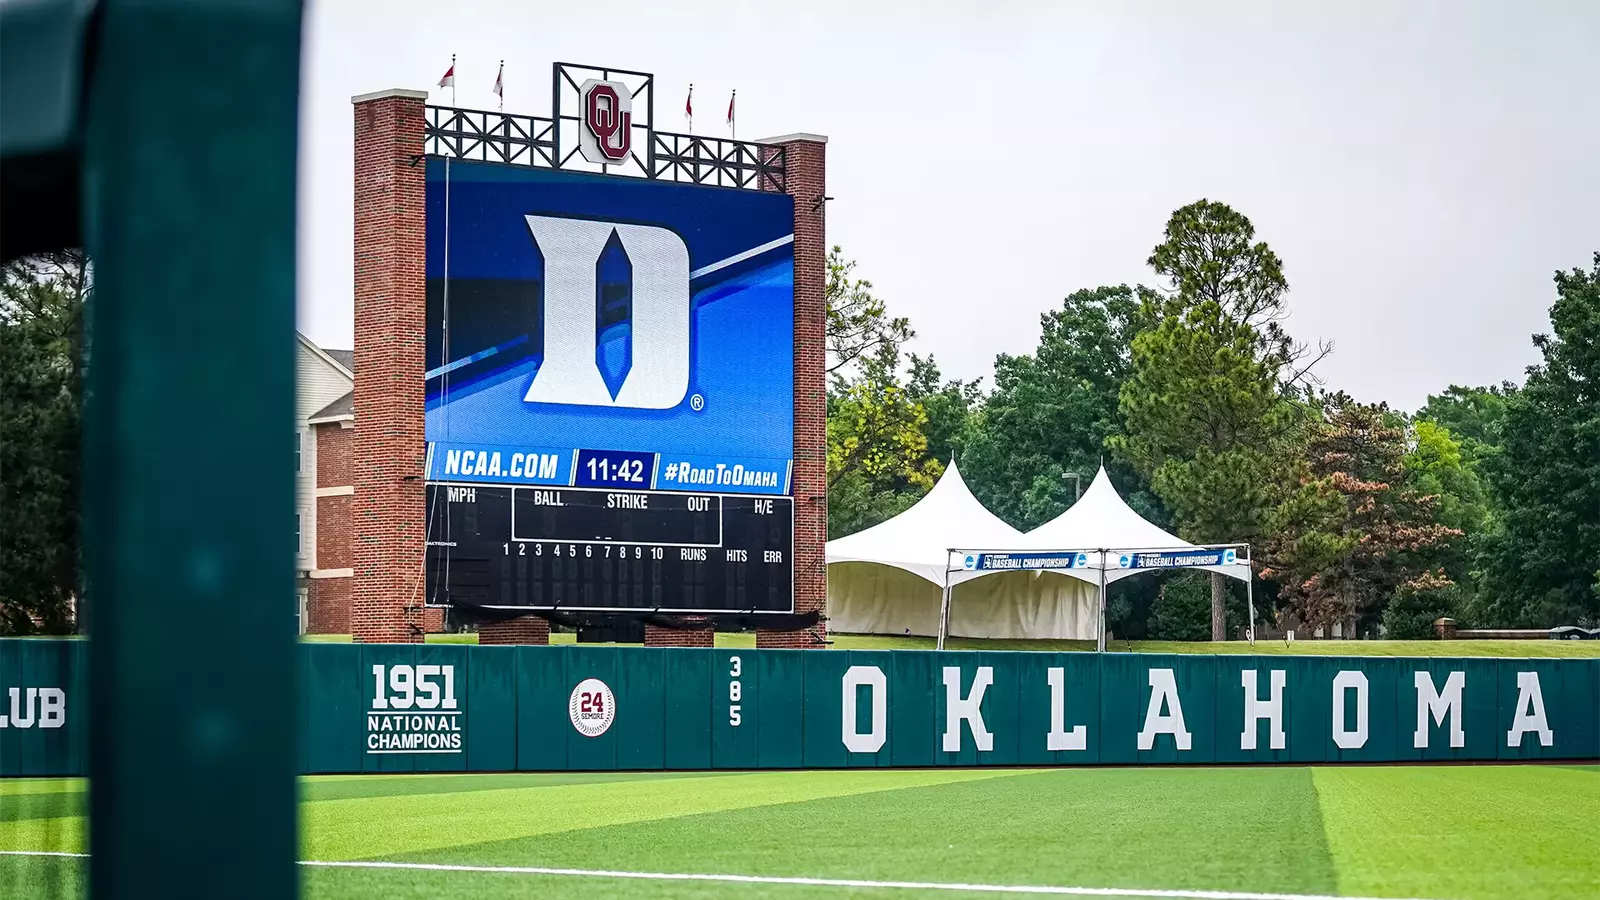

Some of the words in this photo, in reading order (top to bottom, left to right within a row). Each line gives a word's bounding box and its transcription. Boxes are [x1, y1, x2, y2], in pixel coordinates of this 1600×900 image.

[587, 83, 631, 160] OU
[444, 449, 559, 480] NCAA.COM
[586, 457, 644, 482] 11:42
[448, 488, 476, 504] MPH
[534, 490, 564, 507] BALL
[607, 493, 648, 510] STRIKE
[687, 496, 710, 512] OUT
[754, 499, 774, 515] H/E
[503, 542, 509, 556] 1
[518, 543, 526, 556] 2
[535, 543, 542, 557] 3
[553, 544, 561, 557] 4
[569, 545, 576, 558] 5
[585, 545, 592, 558] 6
[604, 546, 611, 559] 7
[619, 546, 627, 560] 8
[635, 547, 642, 560] 9
[651, 547, 664, 561] 10
[680, 548, 707, 562] RUNS
[726, 549, 748, 563] HITS
[763, 550, 782, 564] ERR
[1145, 556, 1174, 567] BASEBALL
[1174, 555, 1219, 566] CHAMPIONSHIP
[992, 557, 1021, 569] BASEBALL
[1022, 557, 1069, 568] CHAMPIONSHIP
[372, 664, 457, 710] 1951
[581, 692, 604, 713] 24
[841, 665, 1555, 754] OKLAHOMA
[367, 715, 461, 732] NATIONAL
[367, 733, 462, 750] CHAMPIONS
